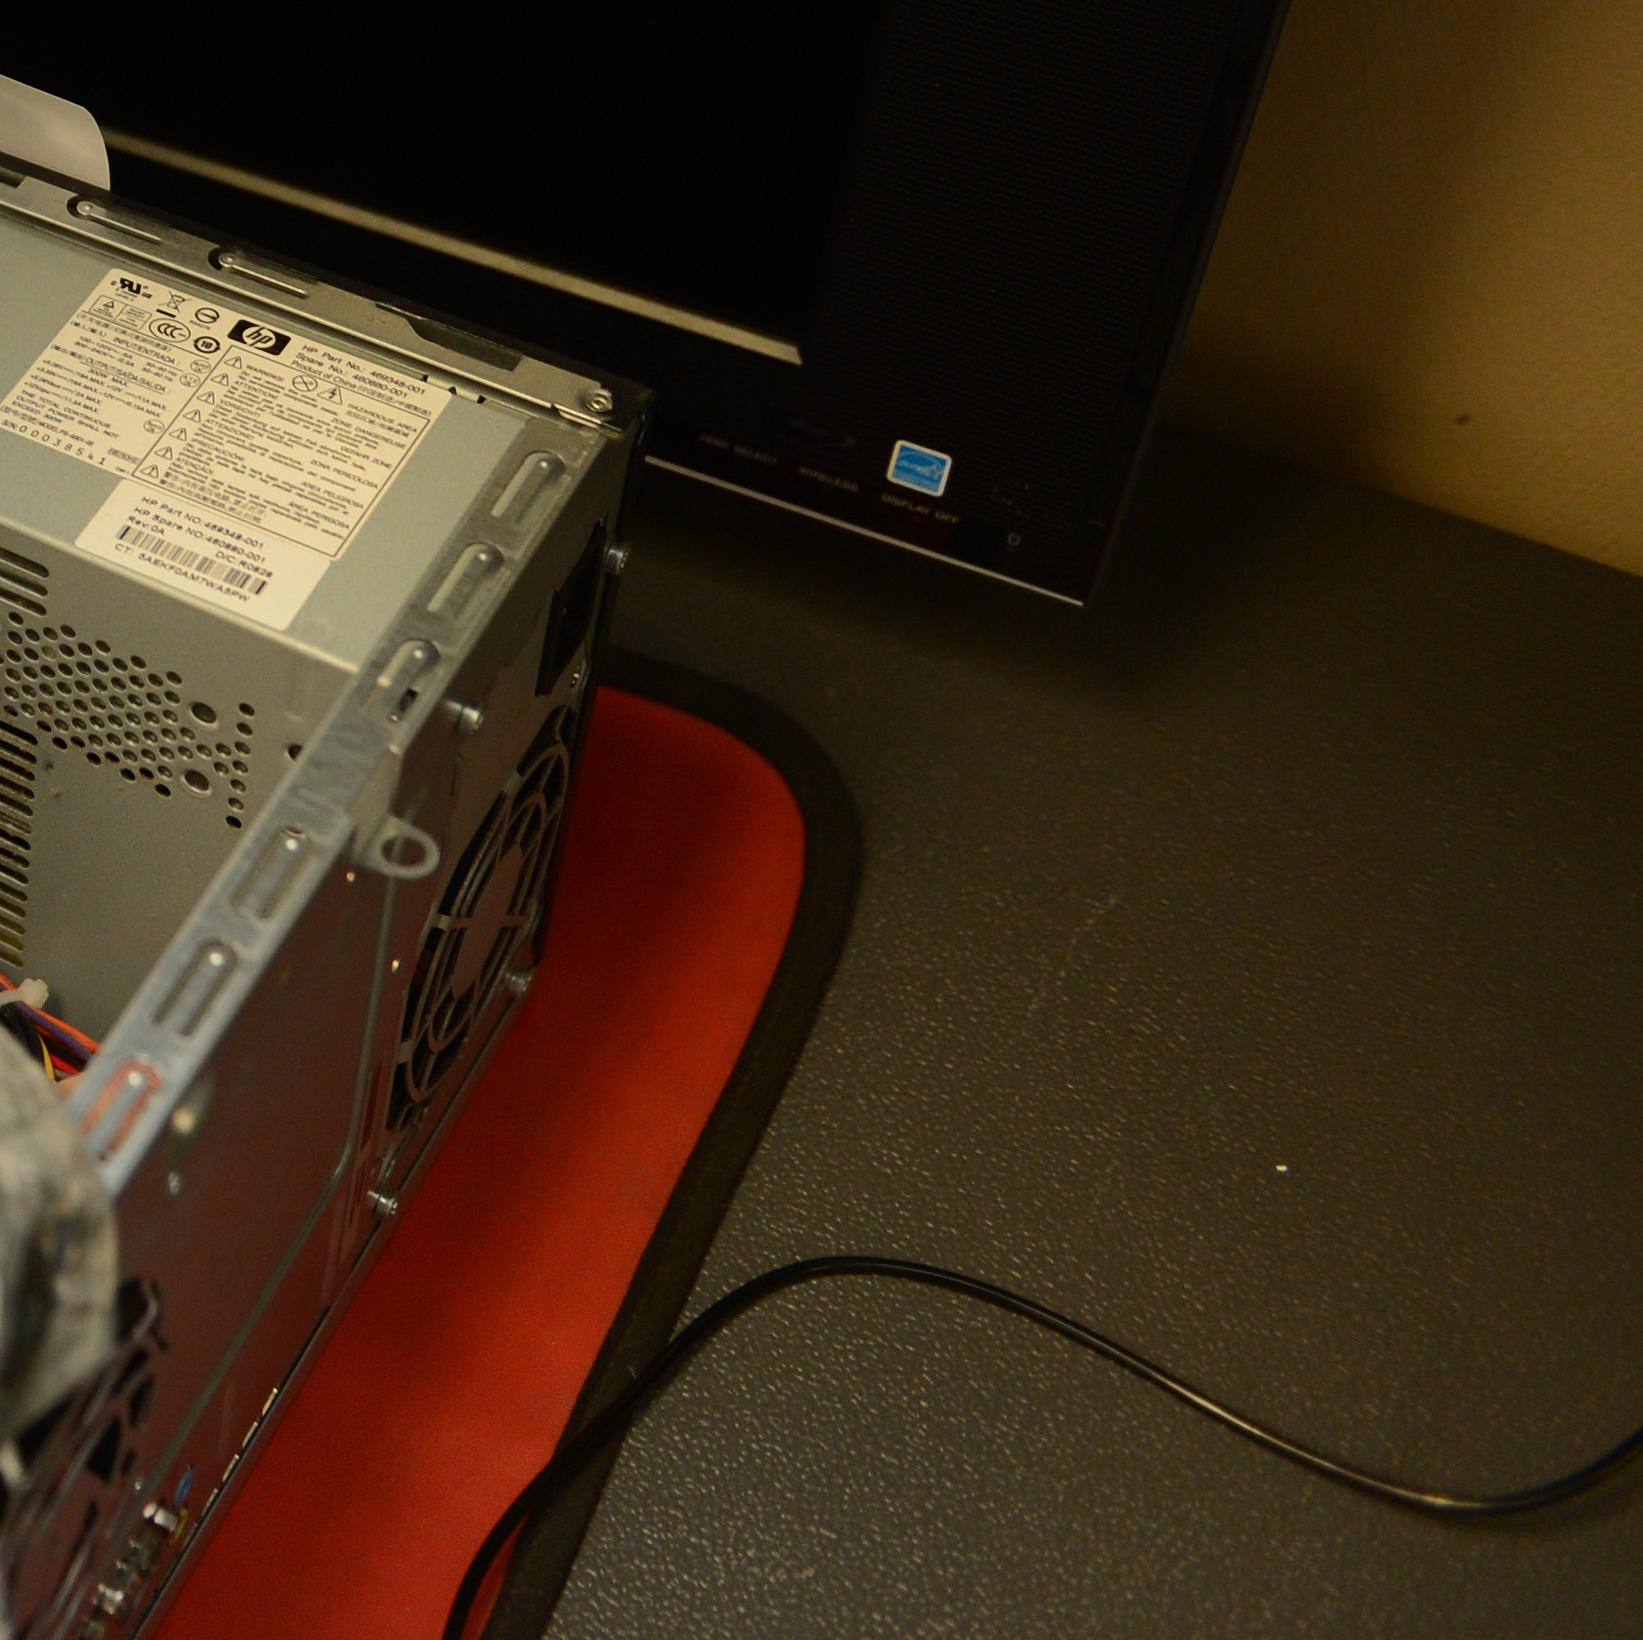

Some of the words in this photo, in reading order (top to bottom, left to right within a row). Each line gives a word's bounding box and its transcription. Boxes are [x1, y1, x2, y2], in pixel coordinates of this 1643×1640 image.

[294, 352, 325, 368] Spare
[301, 344, 318, 354] HP
[321, 352, 342, 364] Part
[289, 359, 324, 376] Product
[322, 372, 333, 380] of
[332, 375, 358, 389] China
[37, 396, 61, 408] TOTAL
[14, 395, 45, 409] OUTPUT
[102, 429, 119, 439] NOT
[140, 496, 158, 506] HP
[158, 503, 183, 517] Part
[133, 507, 150, 517] HP
[150, 514, 184, 531] Spare
